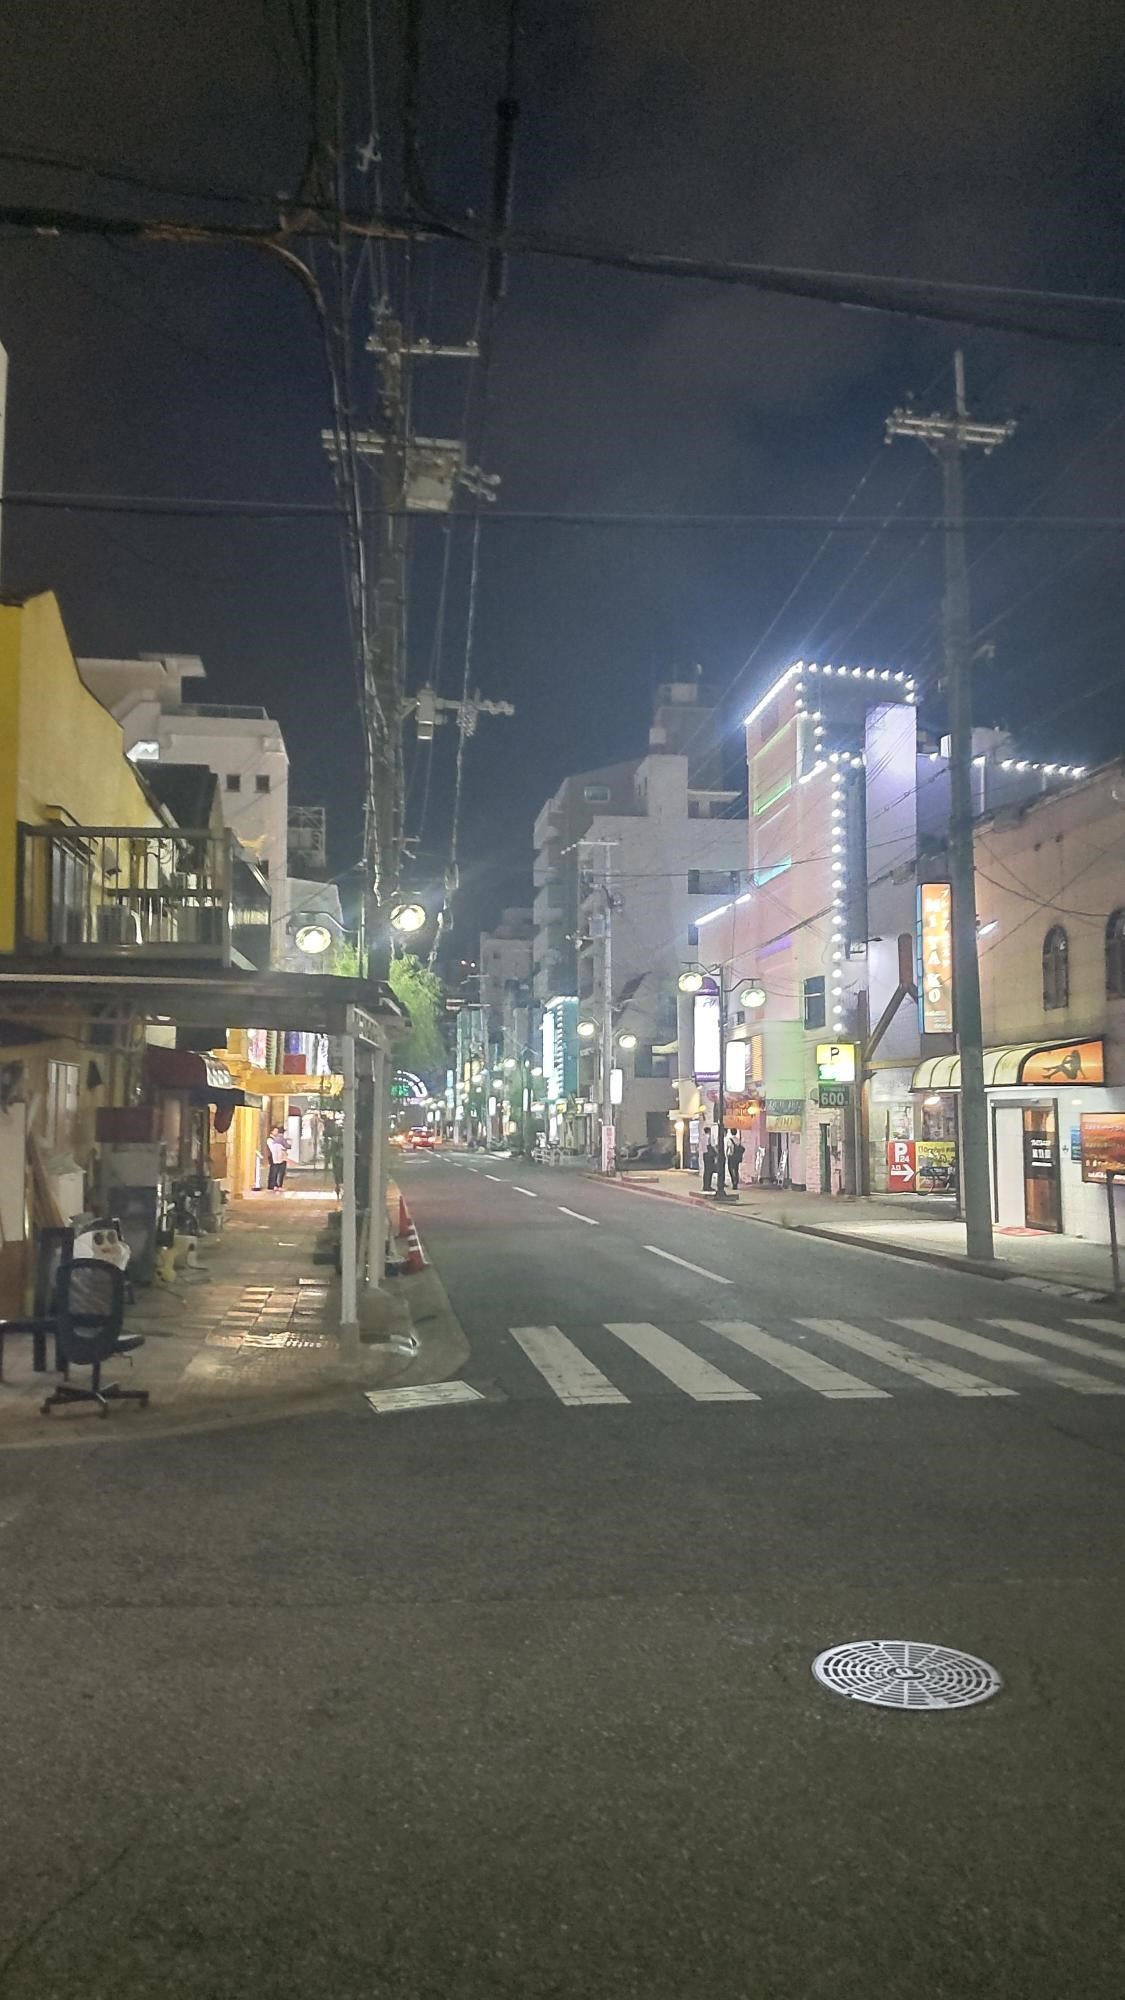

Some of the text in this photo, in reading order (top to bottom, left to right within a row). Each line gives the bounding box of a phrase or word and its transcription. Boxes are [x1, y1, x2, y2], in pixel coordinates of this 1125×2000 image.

[830, 1047, 840, 1061] P
[821, 1092, 845, 1106] 600
[894, 1142, 908, 1163] P
